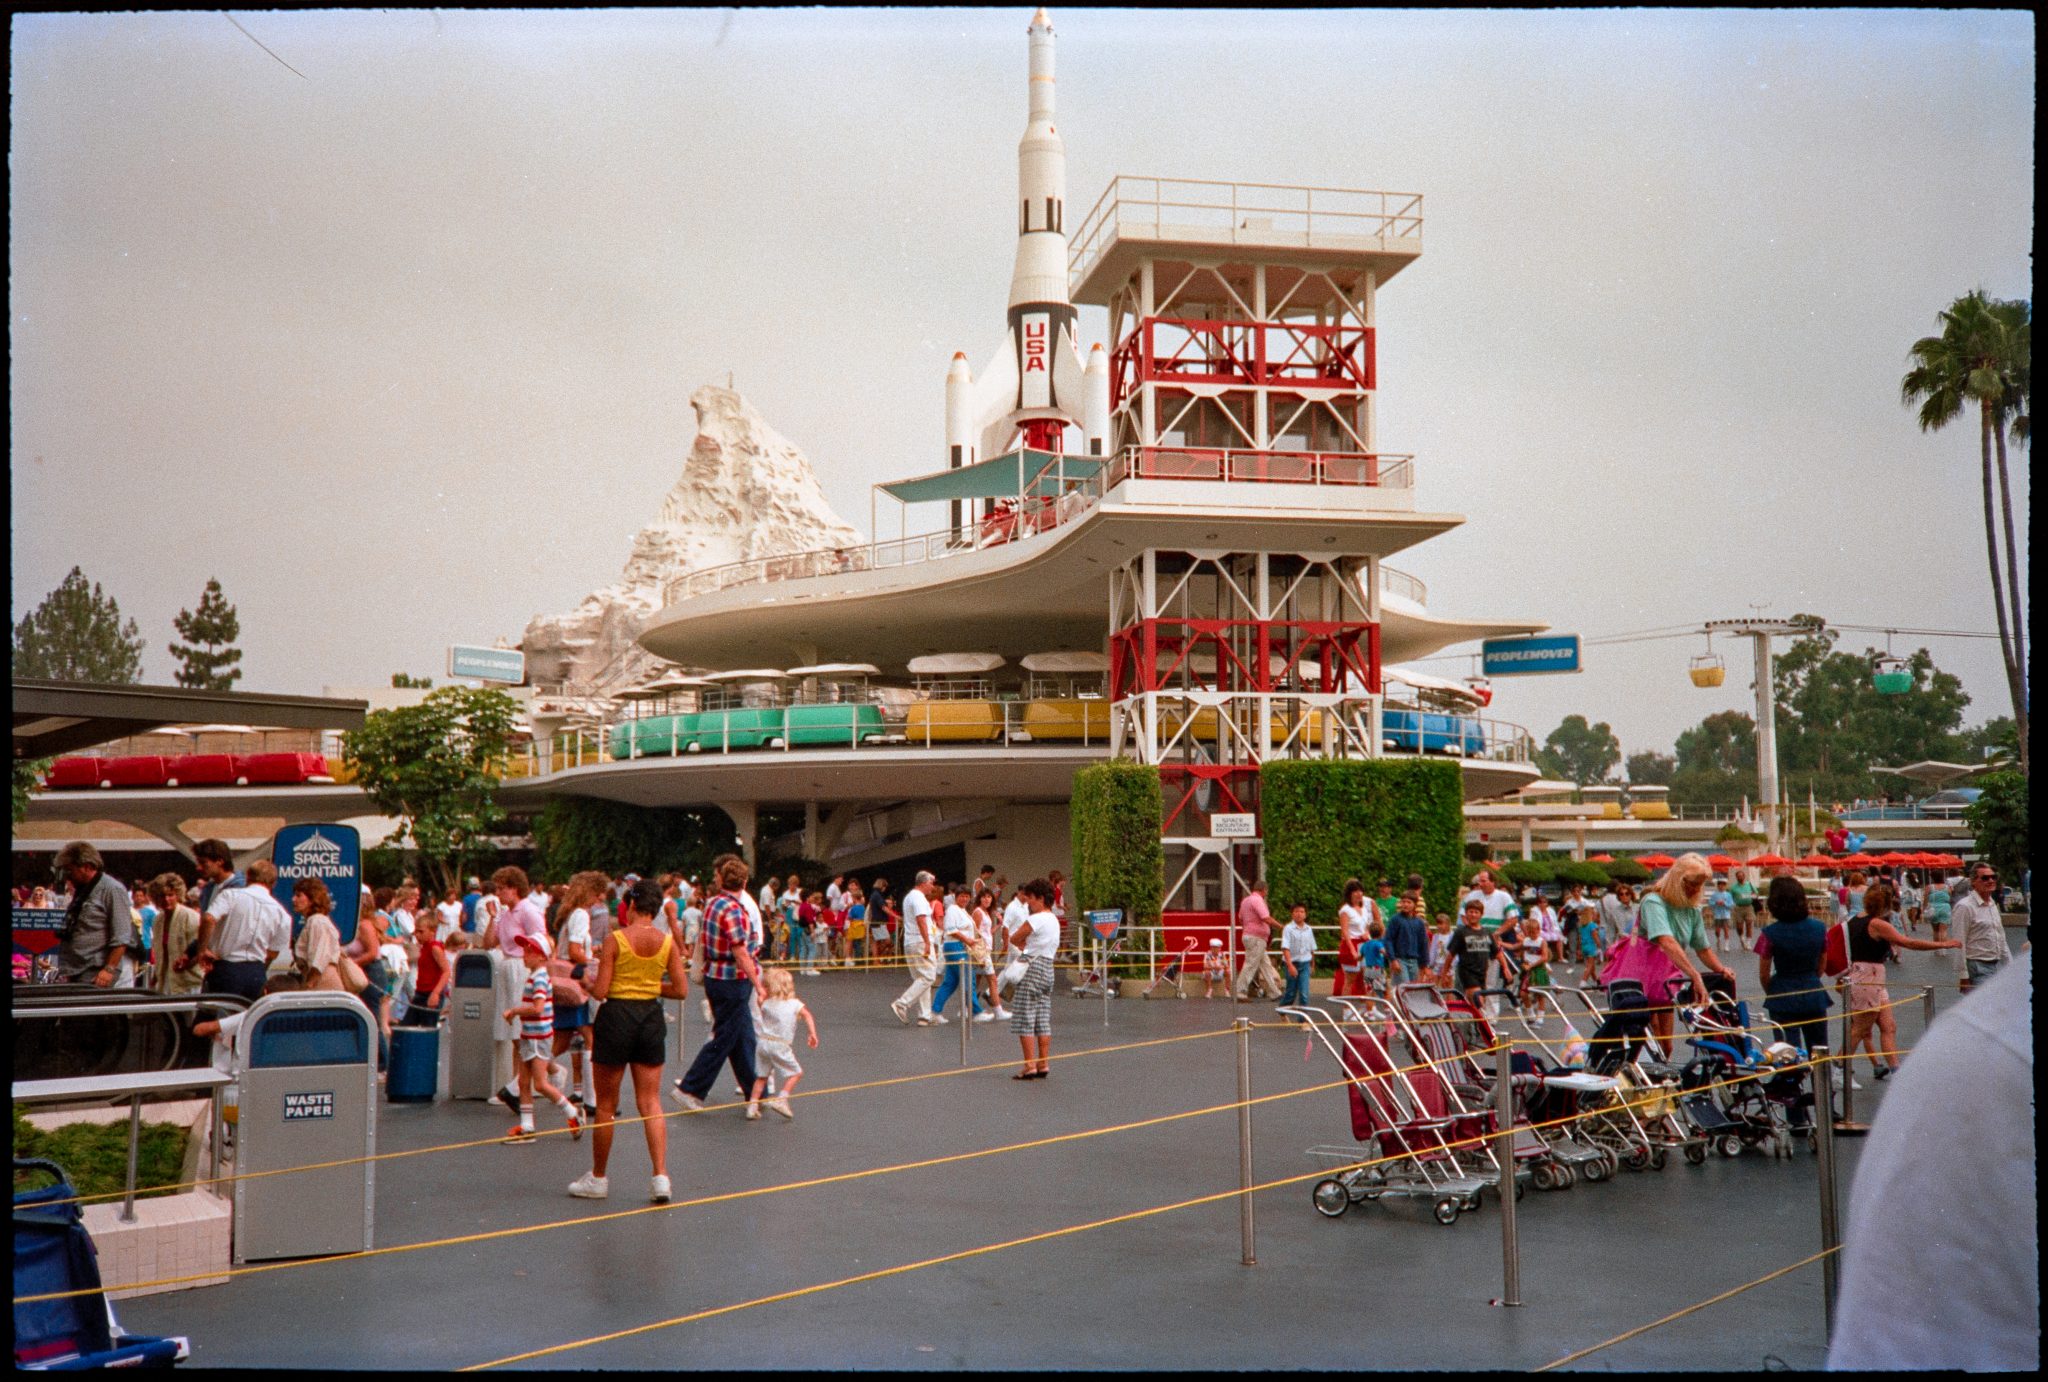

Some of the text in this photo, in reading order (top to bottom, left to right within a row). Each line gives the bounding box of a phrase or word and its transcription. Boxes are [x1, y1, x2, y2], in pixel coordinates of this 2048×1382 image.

[1025, 322, 1045, 372] USA
[1486, 647, 1573, 662] PEOPLEMOVER
[294, 852, 340, 865] SPACE
[279, 865, 354, 878] MOUNTAIN
[286, 1094, 332, 1106] WASTE
[286, 1105, 332, 1117] PAPER
